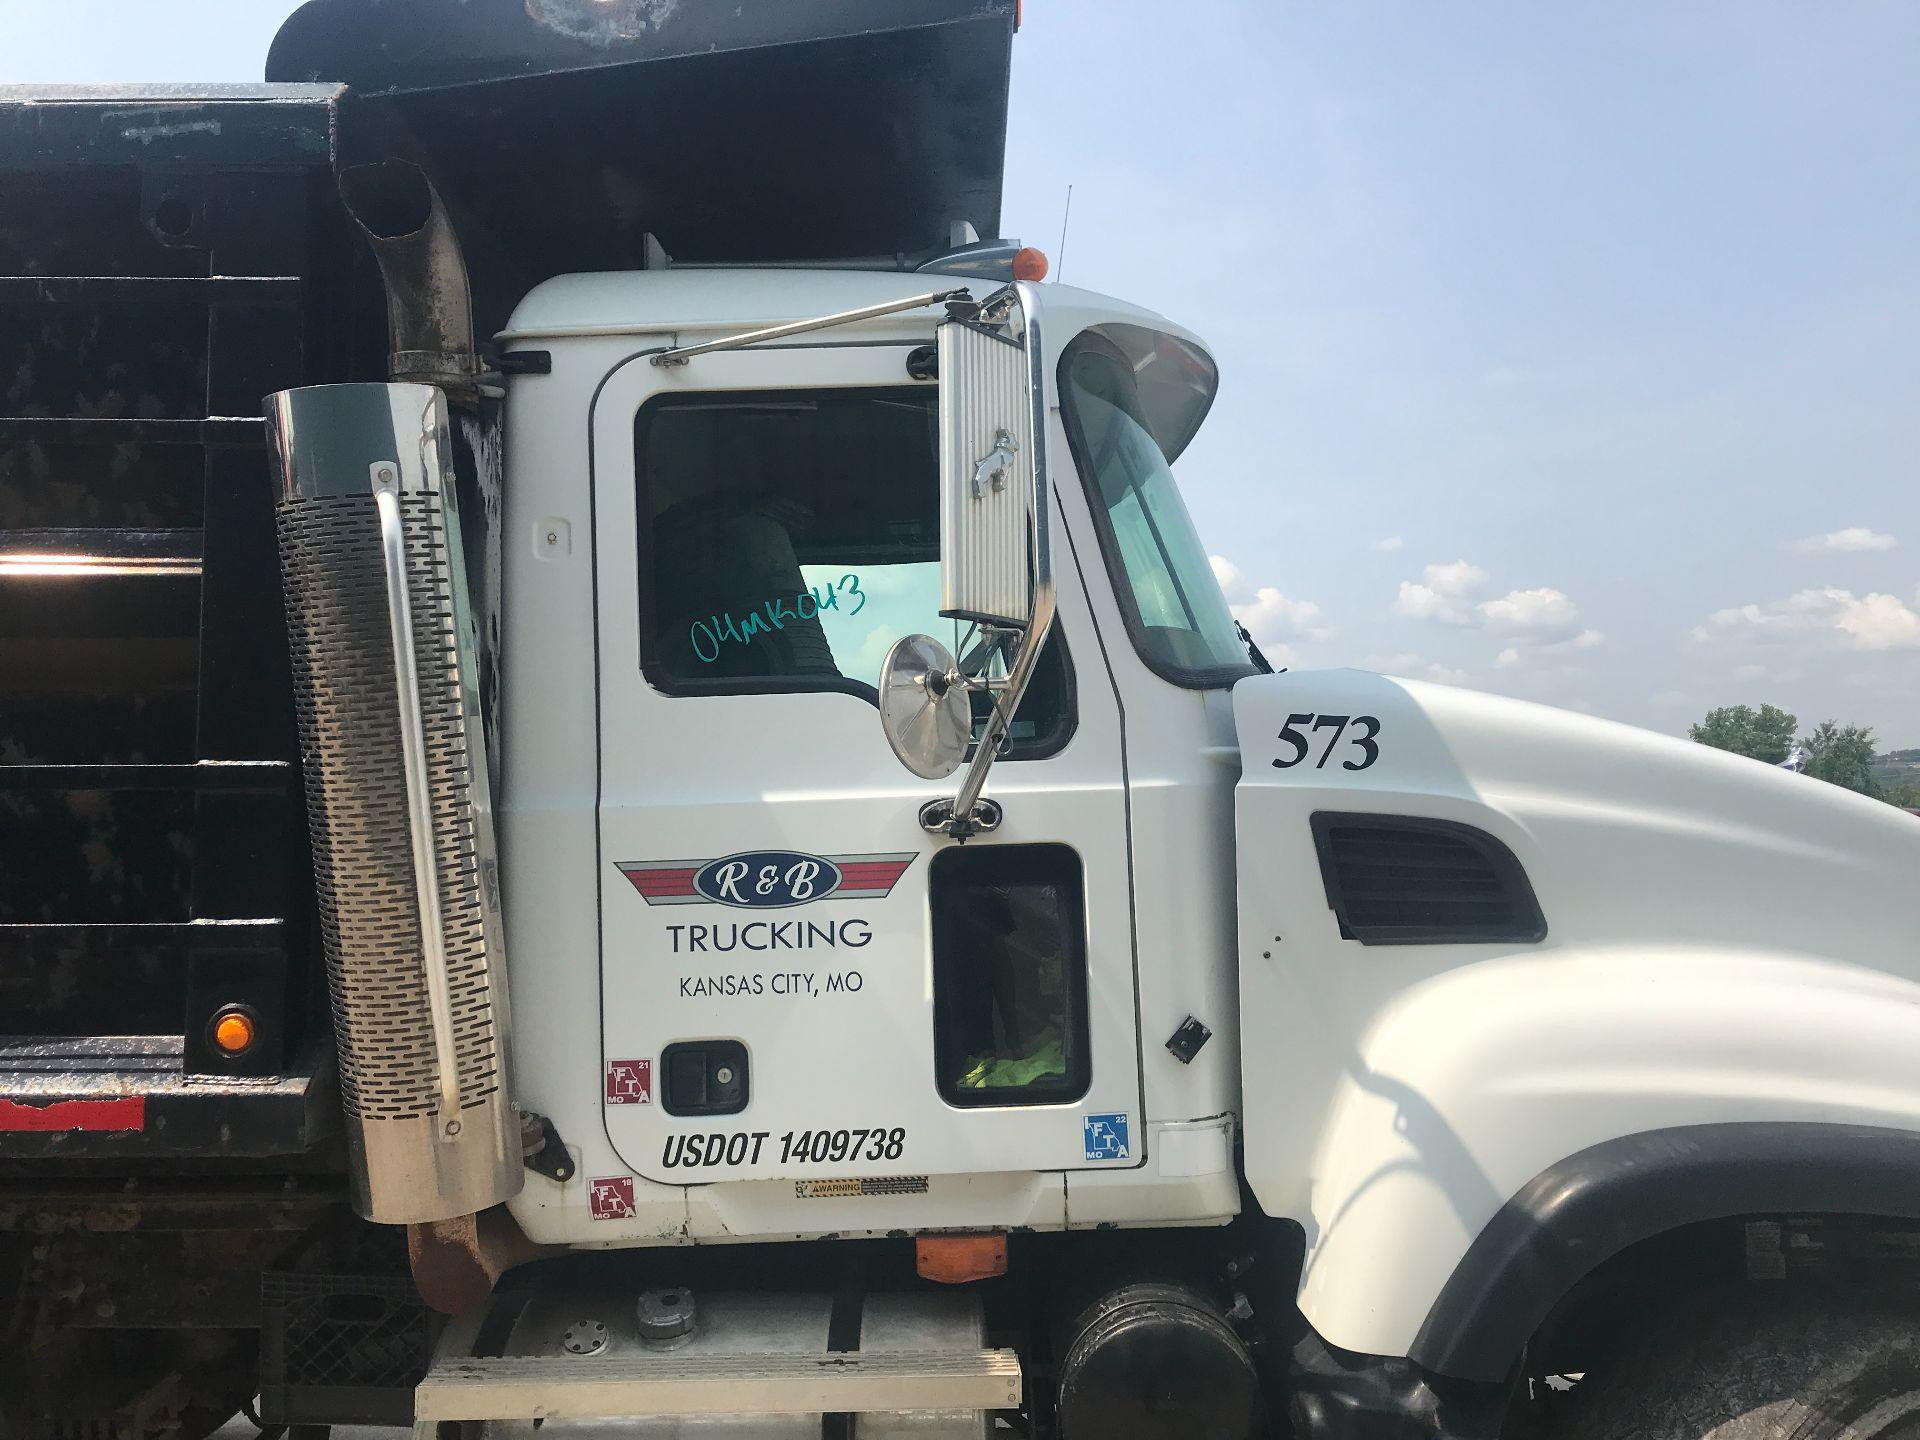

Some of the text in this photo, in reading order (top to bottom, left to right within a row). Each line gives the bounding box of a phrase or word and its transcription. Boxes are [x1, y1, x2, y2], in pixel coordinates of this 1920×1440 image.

[1271, 712, 1381, 771] 573
[666, 919, 873, 953] TRUCKING
[680, 971, 863, 998] KANSAS CITY, MO
[638, 1061, 649, 1069] 21
[607, 1096, 624, 1104] MO
[1115, 1115, 1127, 1124] 22
[662, 1127, 907, 1169] USDOT 1409738
[1086, 1151, 1103, 1159] MO
[818, 1183, 860, 1193] WARNING
[593, 1212, 611, 1220] MO
